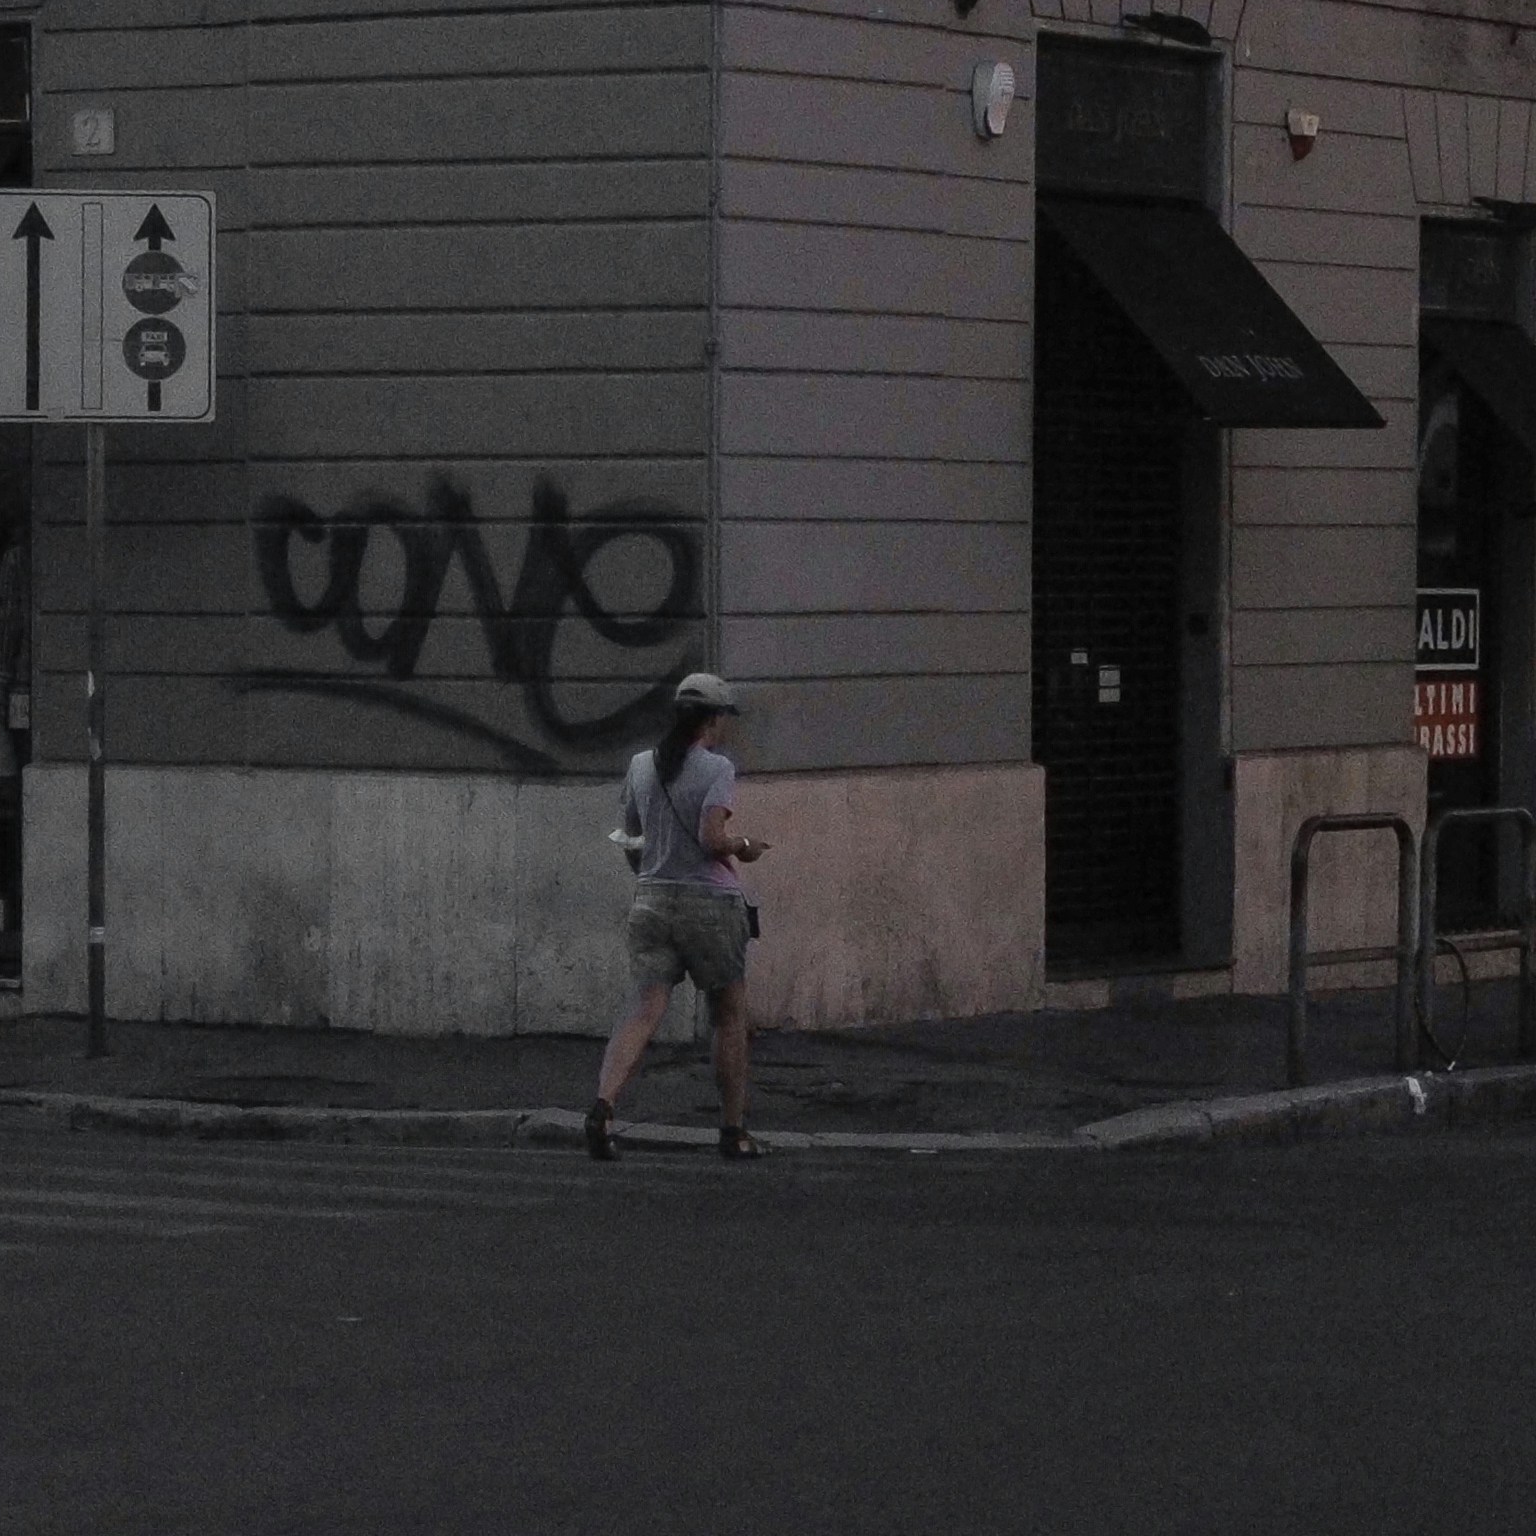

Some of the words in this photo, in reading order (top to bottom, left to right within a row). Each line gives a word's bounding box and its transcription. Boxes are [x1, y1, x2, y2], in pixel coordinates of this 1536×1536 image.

[83, 114, 101, 147] 2
[1197, 354, 1251, 378] DAN
[1418, 609, 1475, 650] ALDI
[1414, 683, 1475, 716] LTIMI
